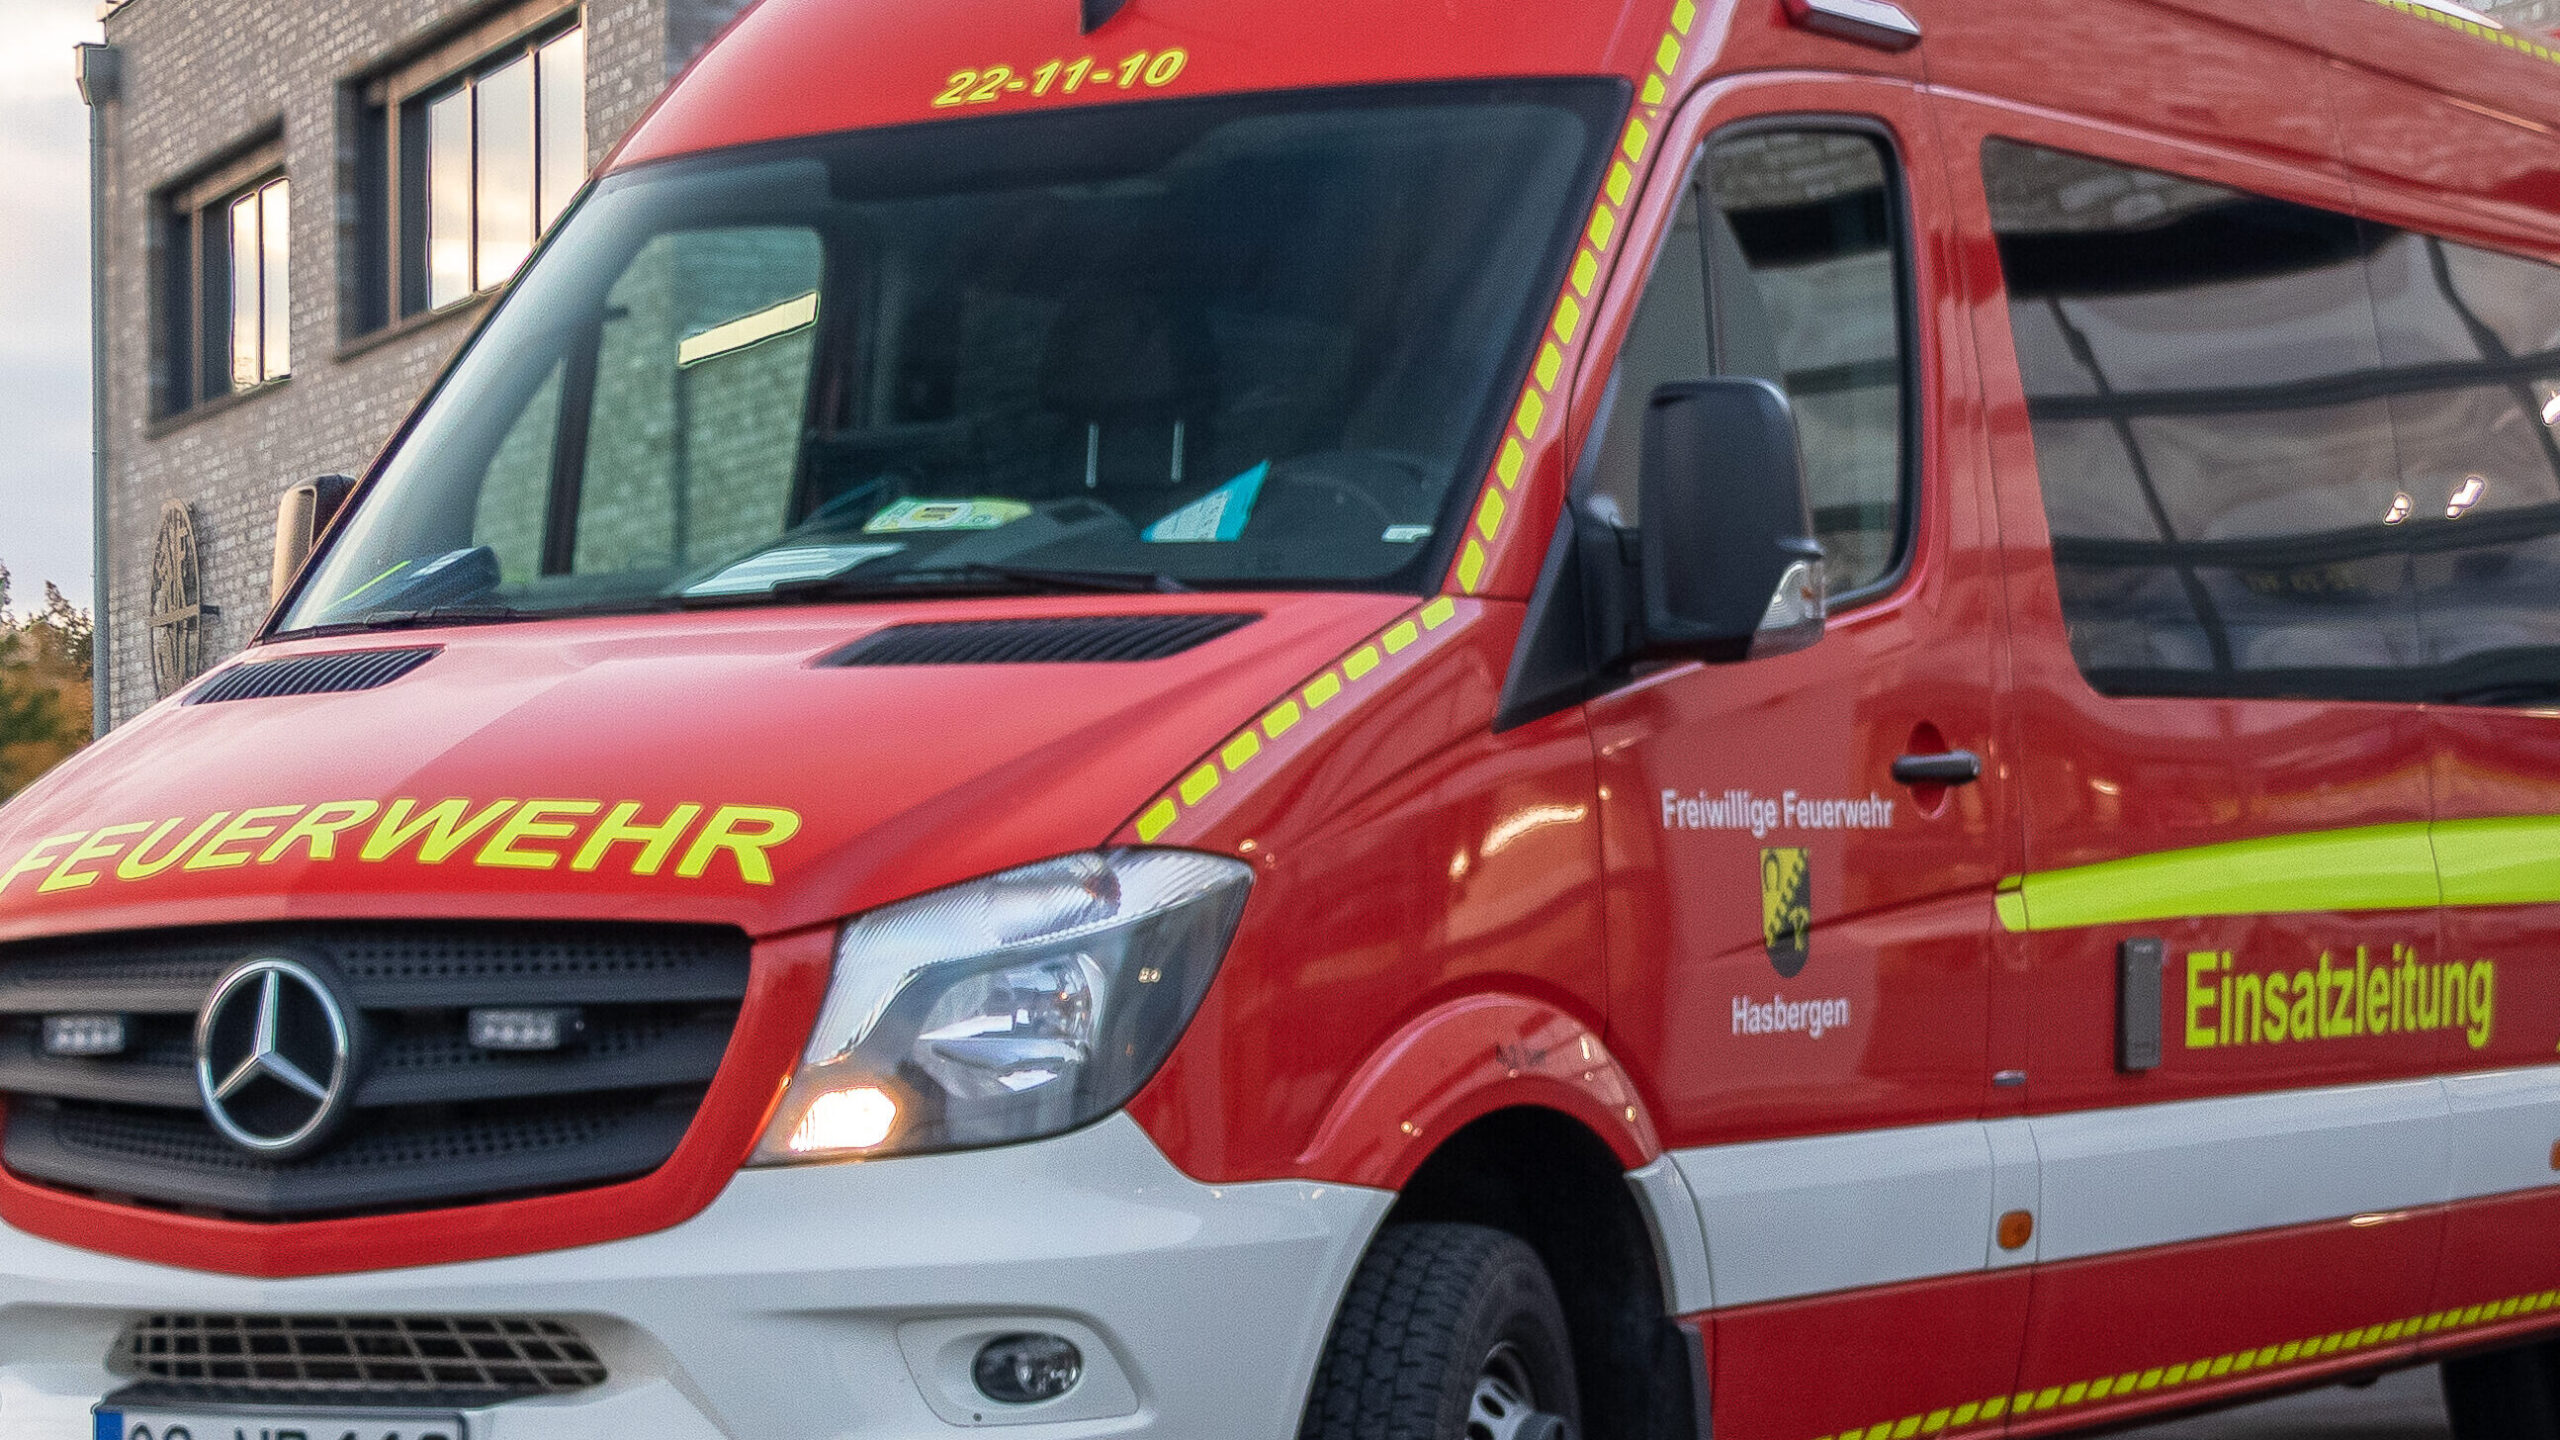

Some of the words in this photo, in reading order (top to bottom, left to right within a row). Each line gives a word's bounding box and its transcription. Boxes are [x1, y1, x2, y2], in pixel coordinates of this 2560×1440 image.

[932, 48, 1187, 107] 22-11-10
[1661, 788, 1778, 839] Freiwillige
[1782, 789, 1894, 829] Feuerwehr
[0, 798, 802, 892] FEUERWEHR
[1731, 994, 1850, 1039] Hasbergen
[2185, 943, 2496, 1049] Einsatzleitung
